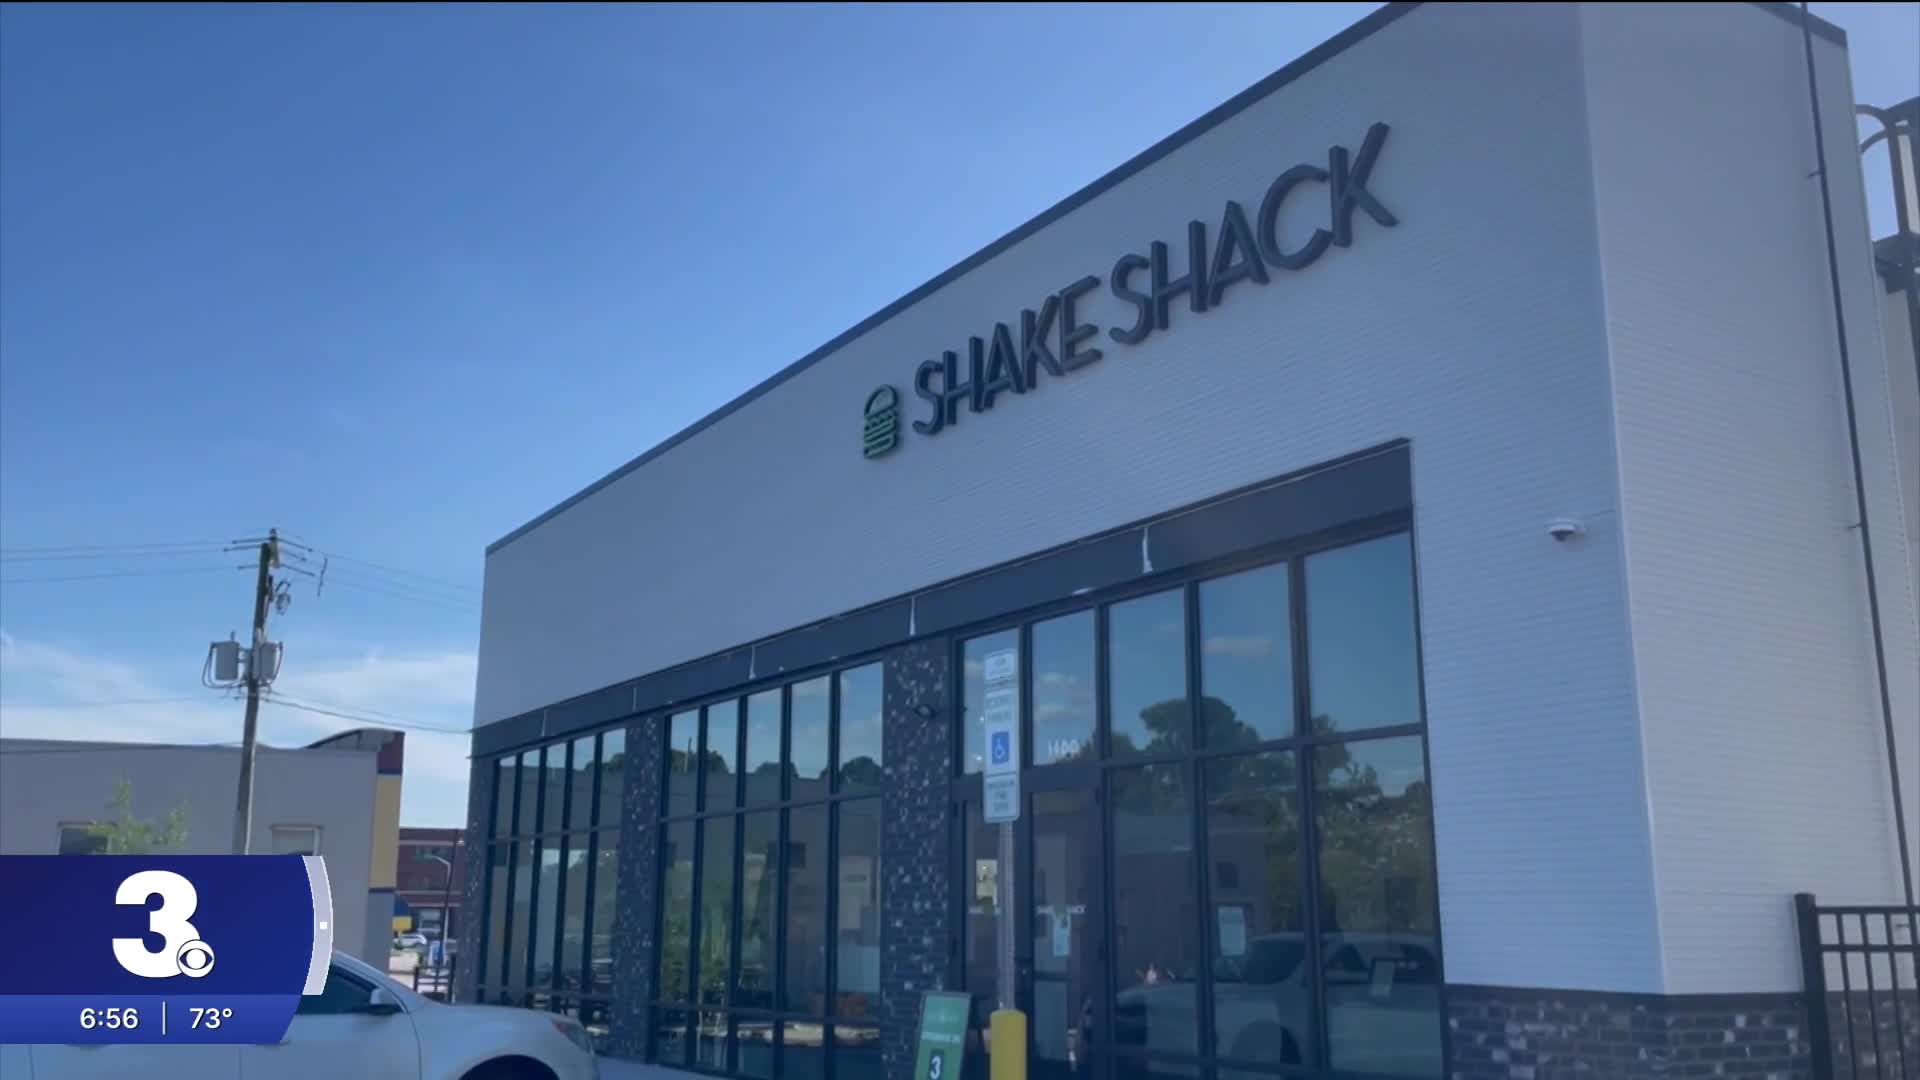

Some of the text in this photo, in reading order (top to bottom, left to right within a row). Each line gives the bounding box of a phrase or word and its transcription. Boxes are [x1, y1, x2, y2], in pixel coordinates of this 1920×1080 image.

[912, 121, 1400, 436] SHAKE SHACK
[930, 1055, 942, 1080] 3
